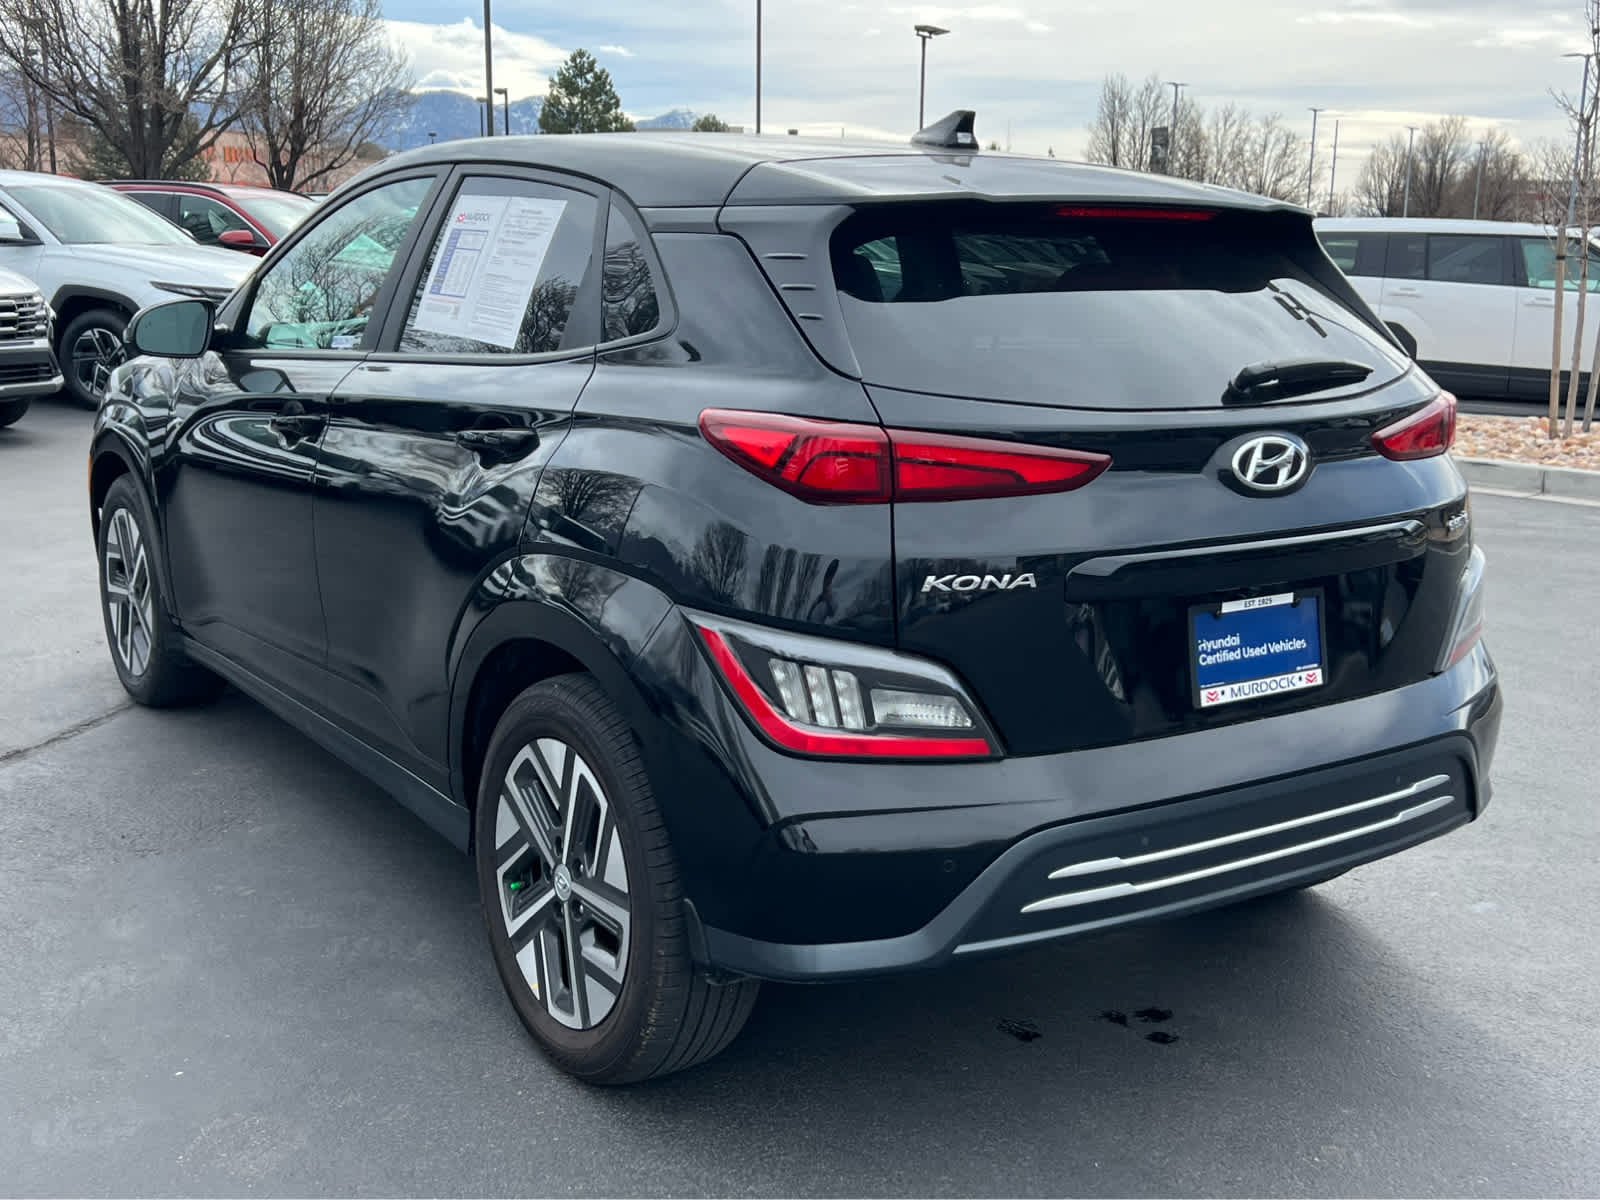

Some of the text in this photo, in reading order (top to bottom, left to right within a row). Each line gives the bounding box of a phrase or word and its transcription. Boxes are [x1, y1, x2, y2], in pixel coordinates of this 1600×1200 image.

[921, 573, 1037, 593] KONA
[1198, 633, 1240, 652] Hyundai
[1199, 638, 1307, 666] Certified Used Vehicles
[1230, 675, 1296, 699] MURDOCK
